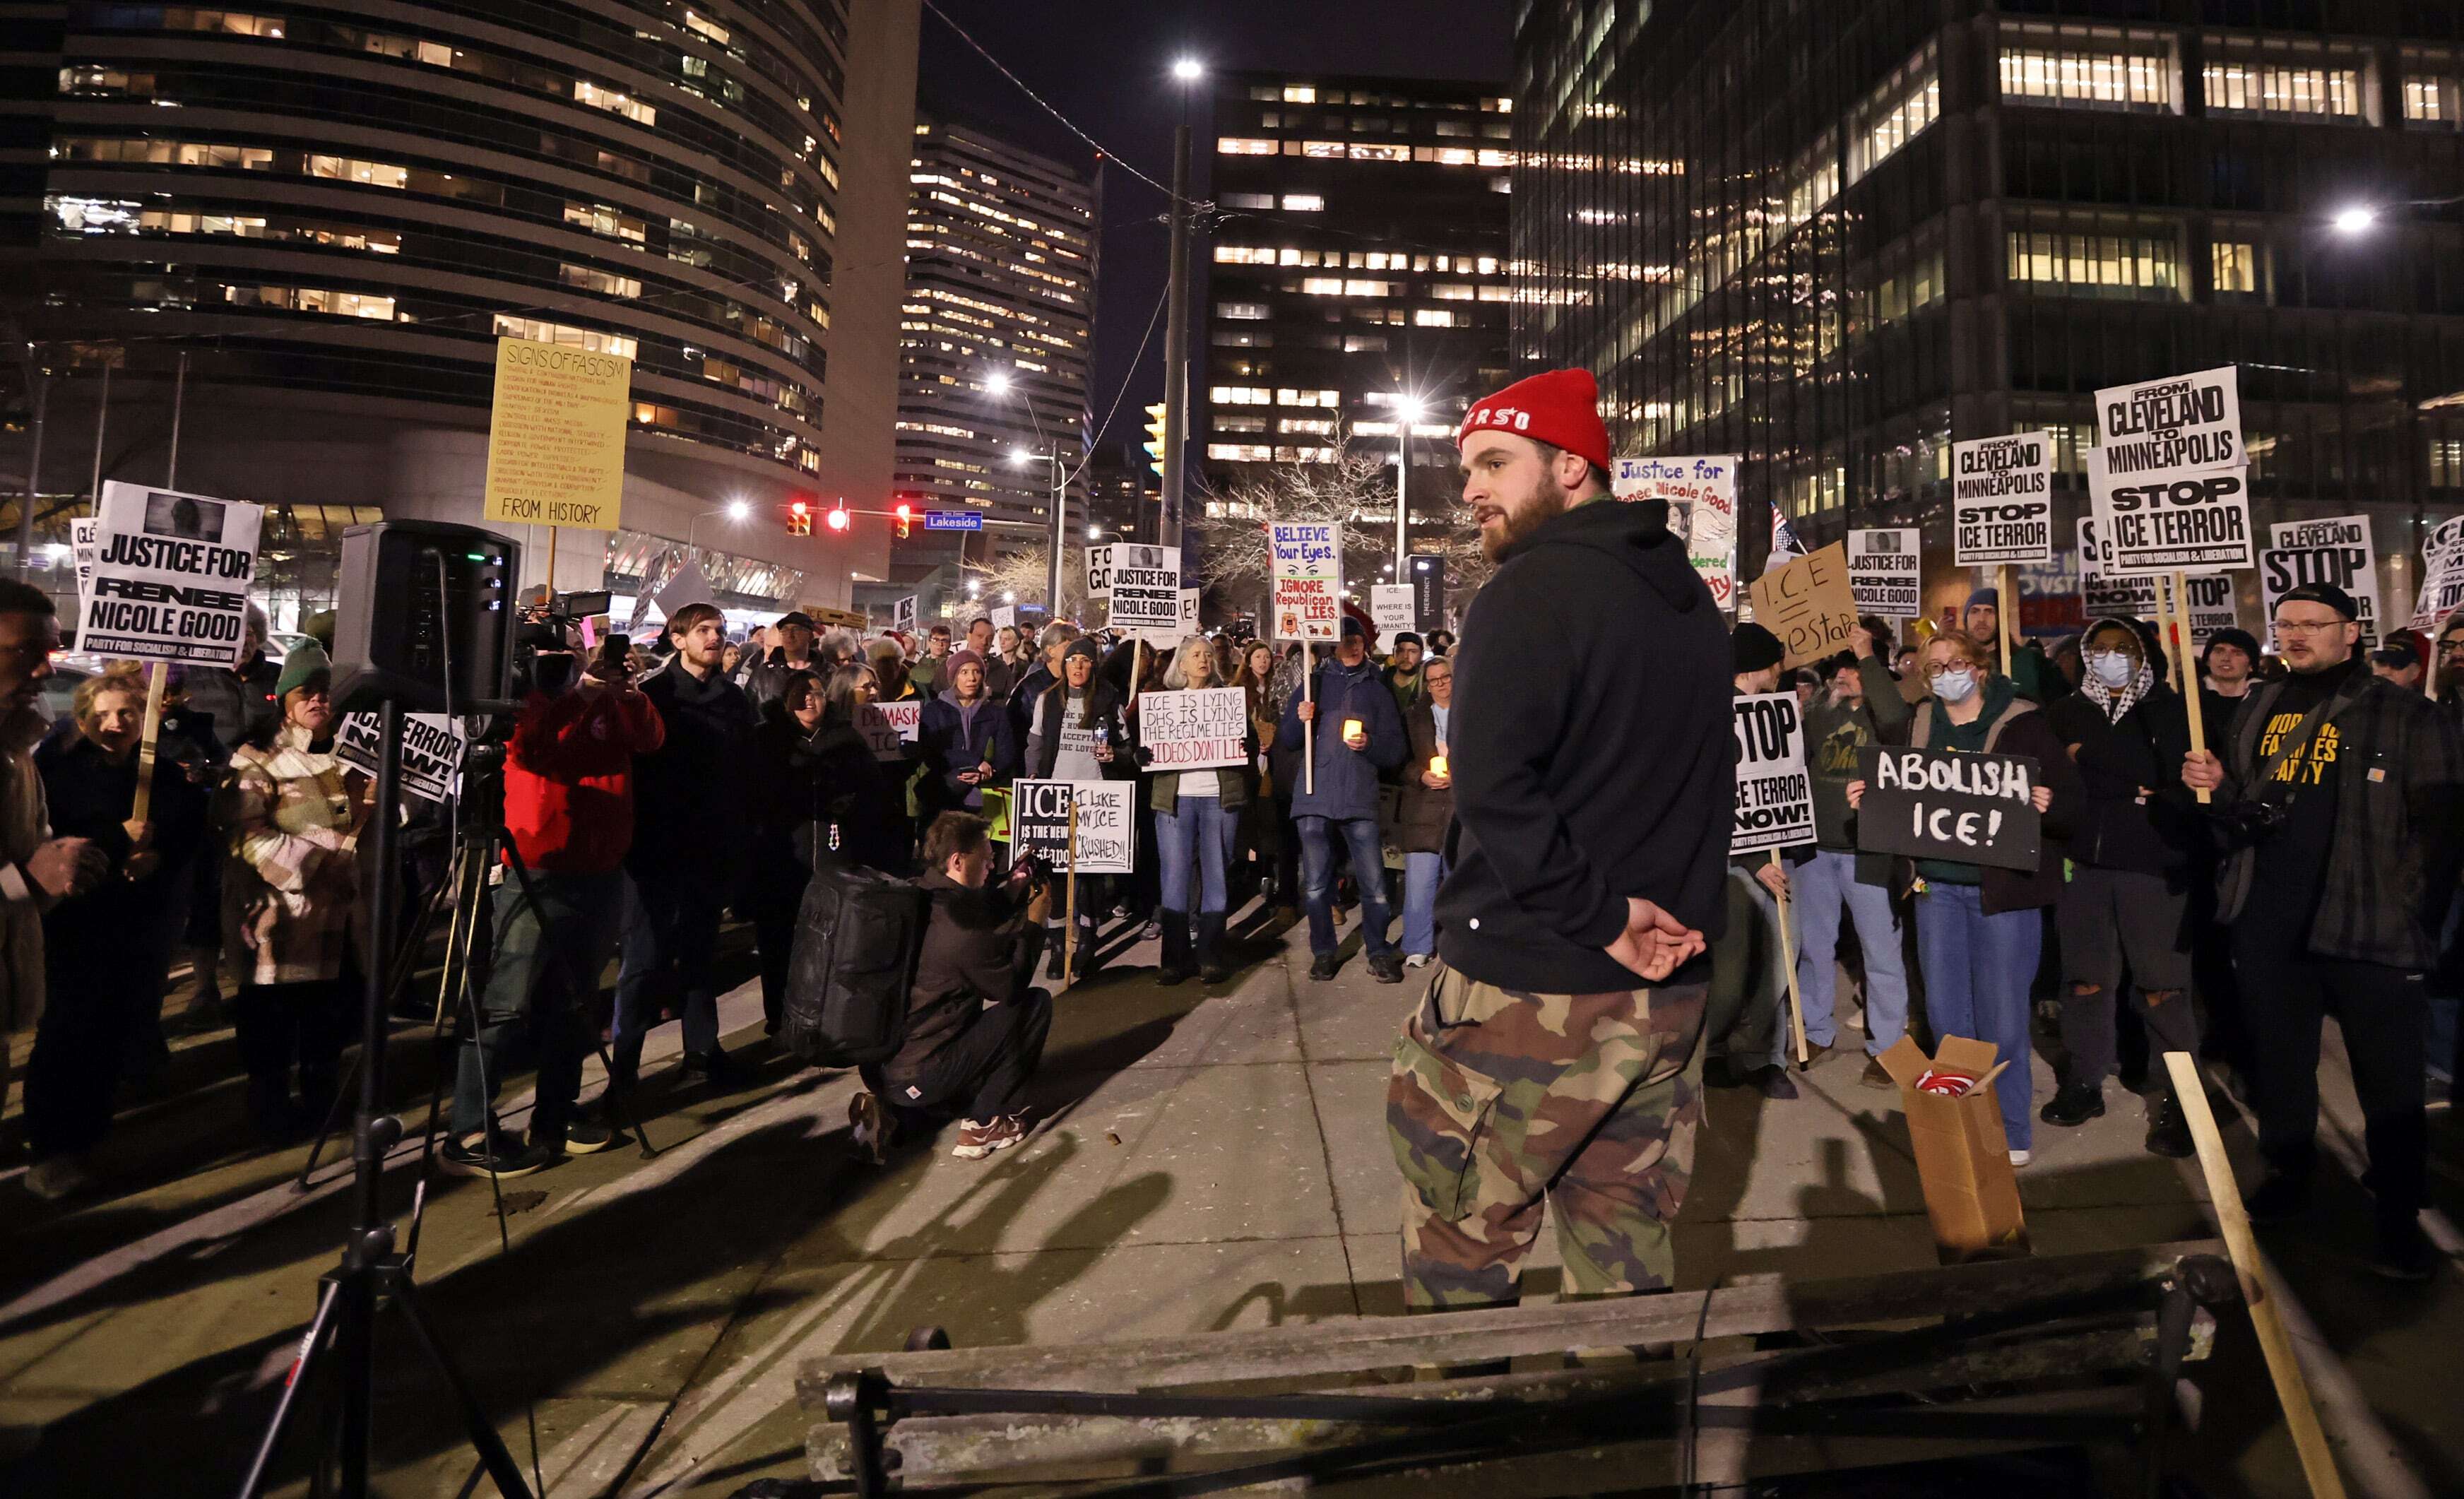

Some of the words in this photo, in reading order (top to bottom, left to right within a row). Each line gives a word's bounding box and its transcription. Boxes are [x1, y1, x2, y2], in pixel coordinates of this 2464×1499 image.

[507, 345, 549, 369] SIGNS
[550, 351, 571, 369] OF
[571, 355, 624, 379] FASCISM
[2134, 381, 2189, 401] FROM
[2108, 385, 2225, 437] CLEVELAND
[1980, 439, 2019, 451] FROM
[2151, 429, 2179, 441] TO
[1961, 443, 2040, 474] CLEVELAND
[2107, 430, 2233, 474] MINNEAPOLIS
[1621, 461, 1684, 479] Justice
[1693, 460, 1724, 480] for
[1957, 473, 2045, 499] MINNEAPOLIS
[2111, 476, 2241, 511] STOP
[1656, 482, 1699, 499] Nicole
[1701, 486, 1733, 516] Good
[502, 497, 541, 519] FROM
[549, 501, 601, 523] HISTORY
[1959, 503, 2047, 524] STOP
[930, 516, 978, 527] Lakeside
[2114, 513, 2149, 548] ICE
[2150, 505, 2245, 545] TERROR
[1274, 526, 1329, 543] BELIEVE
[1959, 526, 1982, 549] ICE
[1985, 521, 2047, 547] TERROR
[2280, 524, 2362, 548] CLEVELAND
[101, 533, 205, 574] JUSTICE
[205, 546, 251, 579] FOR
[1274, 543, 1299, 559] Your
[2120, 554, 2140, 564] PARTY
[2141, 553, 2154, 564] FOR
[2154, 550, 2190, 564] SOCIALISM
[2191, 551, 2201, 562] &
[2201, 547, 2245, 561] LIBERATION
[1851, 555, 1895, 570] JUSTICE
[1895, 555, 1917, 570] FOR
[2265, 548, 2367, 593] STOP
[1114, 569, 1156, 586] JUSTICE
[1157, 571, 1177, 587] FOR
[1280, 579, 1324, 593] IGNORE
[1851, 576, 1917, 587] RENEE
[95, 576, 244, 612] RENEE
[1113, 588, 1177, 600] RENEE
[1275, 592, 1333, 610] Republican
[1852, 588, 1886, 603] NICOLE
[1888, 588, 1917, 603] GOOD
[2187, 578, 2230, 607] TOP
[900, 598, 913, 621] ICE
[1113, 600, 1148, 615] NICOLE
[1149, 602, 1176, 616] GOOD
[1304, 606, 1338, 620] LIES.
[88, 600, 178, 635] NICOLE
[178, 610, 241, 641] GOOD
[2196, 613, 2234, 627] TERROR
[85, 637, 114, 650] PARTY
[114, 640, 132, 651] FOR
[133, 641, 177, 656] SOCIALISM
[177, 646, 187, 656] &
[188, 646, 233, 660] LIBERATION
[1144, 696, 1171, 711] ICE
[1180, 694, 1197, 708] IS
[1203, 692, 1241, 707] LYING
[862, 706, 920, 726] DEMASK
[1147, 711, 1174, 726] DHS
[1180, 709, 1197, 724] IS
[1203, 707, 1244, 723] LYING
[402, 716, 461, 762] ERROR
[1142, 726, 1165, 741] THE
[1168, 723, 1211, 740] REGIME
[1215, 723, 1244, 737] LIES
[1060, 743, 1073, 752] ORE
[1194, 740, 1221, 762] DONT
[1877, 750, 2030, 805] ABOLISH
[1076, 789, 1086, 807] I
[1090, 790, 1121, 808] LIKE
[1751, 774, 1807, 807] TERROR
[1021, 785, 1070, 818] ICE
[1077, 810, 1093, 829] MY
[1093, 810, 1119, 829] ICE
[1732, 803, 1810, 831] NOW!
[1913, 802, 2002, 847] ICE!
[1021, 824, 1031, 839] IS
[1032, 824, 1048, 839] THE
[1051, 825, 1070, 839] NEW
[1075, 834, 1126, 861] CRUSHED!!
